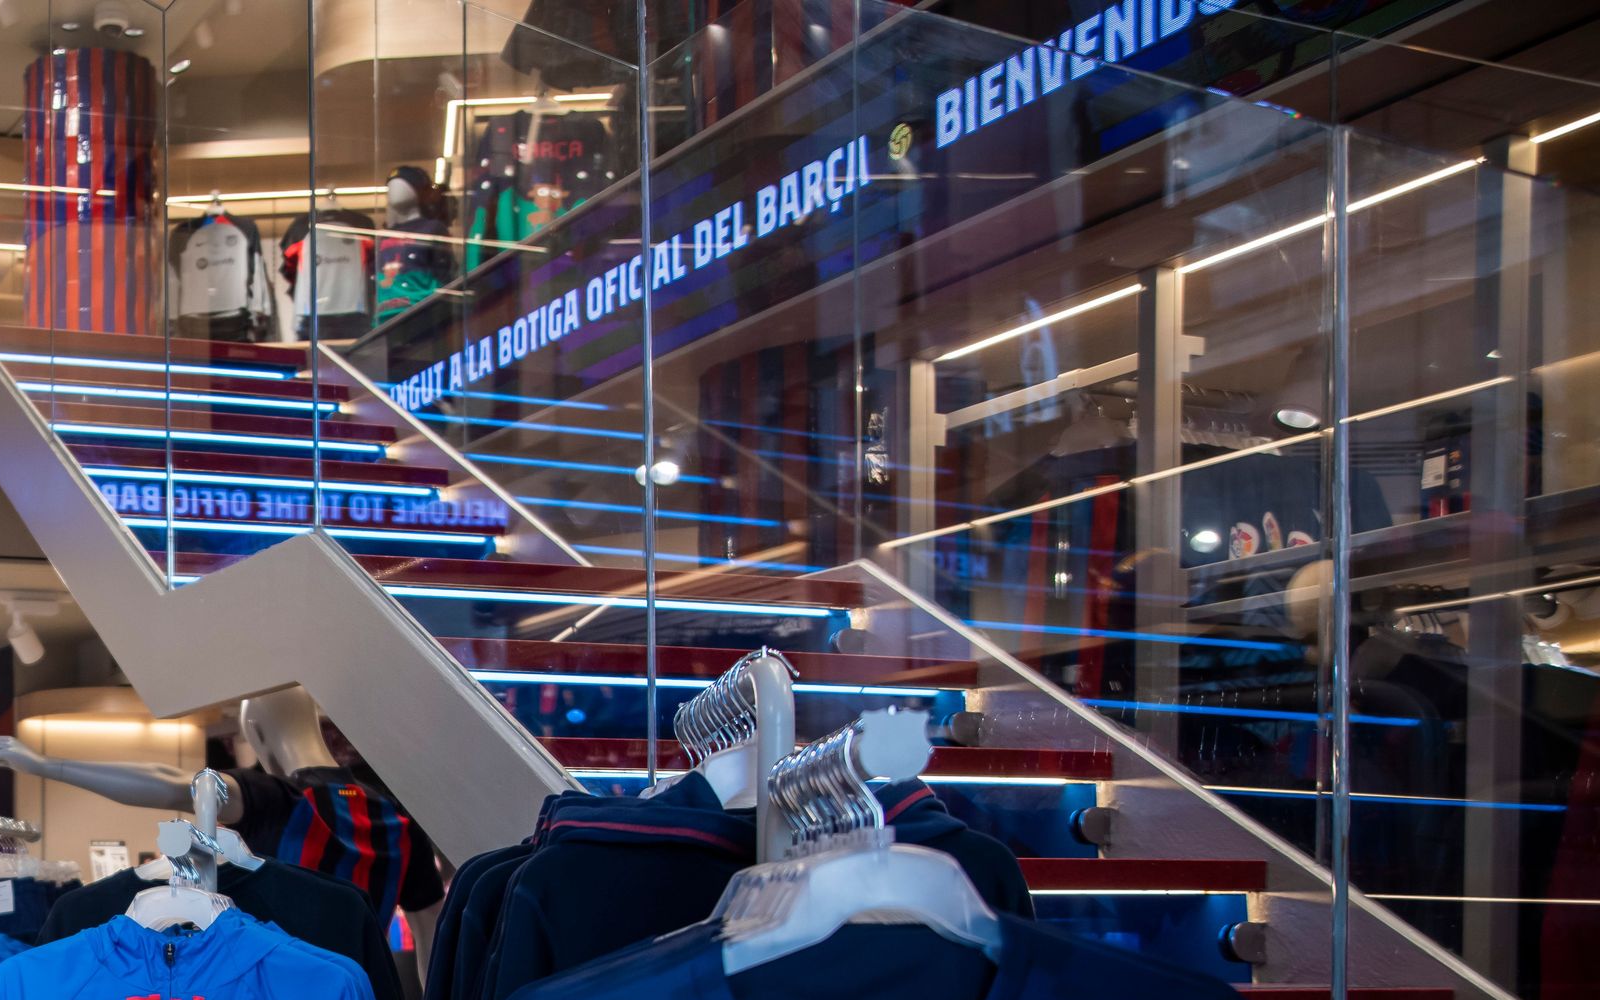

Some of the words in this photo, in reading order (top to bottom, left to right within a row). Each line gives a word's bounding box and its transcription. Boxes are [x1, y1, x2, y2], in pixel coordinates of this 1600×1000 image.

[936, 0, 1236, 150] BIENVENID
[449, 352, 463, 393] A
[467, 335, 493, 383] LA
[498, 288, 580, 368] BOTIGA
[586, 233, 687, 321] OFICAL
[693, 200, 749, 270] DEL
